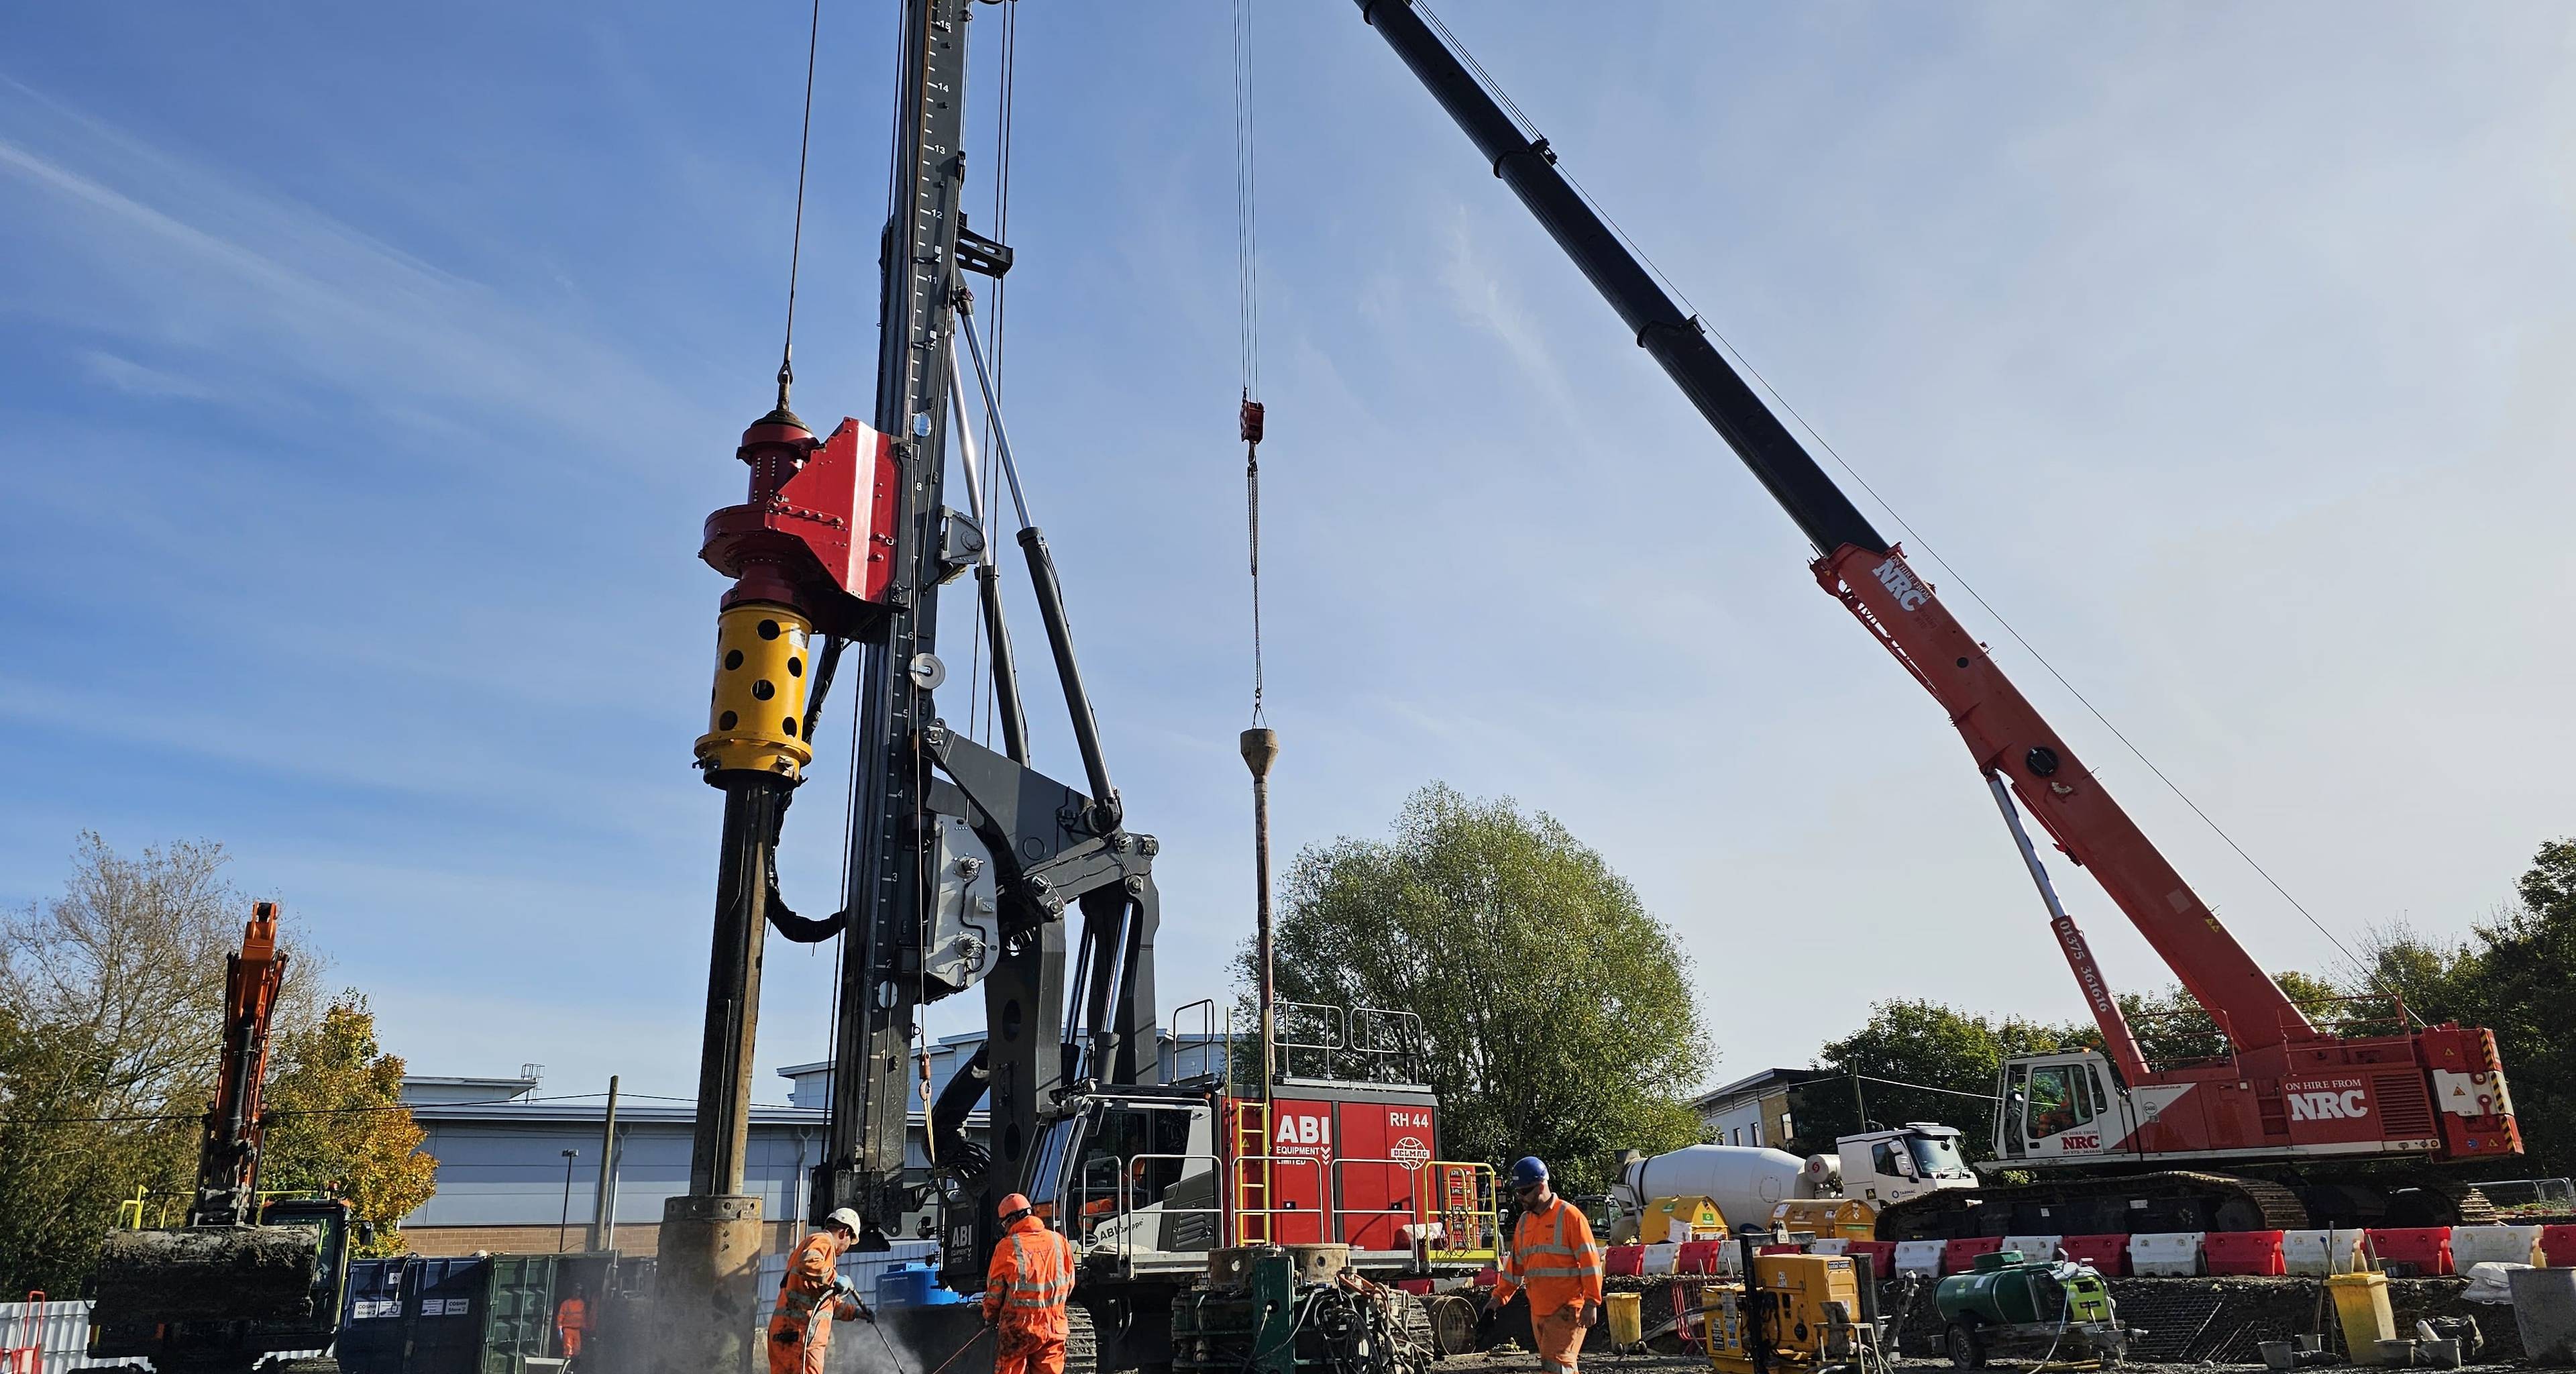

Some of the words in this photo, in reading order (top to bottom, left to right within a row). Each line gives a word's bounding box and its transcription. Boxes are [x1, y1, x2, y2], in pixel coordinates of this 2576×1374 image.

[940, 20, 951, 30] 15
[938, 83, 949, 93] 14
[934, 144, 946, 154] 13
[931, 209, 943, 219] 12
[927, 274, 938, 284] 11
[916, 482, 922, 490] 8
[1890, 555, 1901, 566] ON
[1899, 565, 1915, 582] HIRE
[1914, 578, 1931, 600] FROM
[1872, 558, 1928, 611] NRC
[908, 631, 914, 640] 6
[903, 709, 908, 718] 5
[897, 789, 903, 798] 4
[892, 872, 898, 882] 3
[886, 959, 892, 968] 2
[2059, 920, 2086, 960] 01375
[2080, 965, 2110, 1012] 361616
[2285, 1082, 2300, 1091] ON
[2303, 1079, 2329, 1090] HIRE
[2332, 1078, 2361, 1088] FROM
[2287, 1090, 2368, 1121] NRC
[1390, 1112, 1409, 1127] RH
[1413, 1114, 1429, 1128] 44
[1276, 1115, 1330, 1145] ABI
[2061, 1135, 2100, 1150] NRC
[1276, 1146, 1320, 1155] EQUIPMENT
[1394, 1149, 1428, 1157] DELMAG
[951, 1224, 972, 1248] ABI
[1100, 1226, 1118, 1241] ABI
